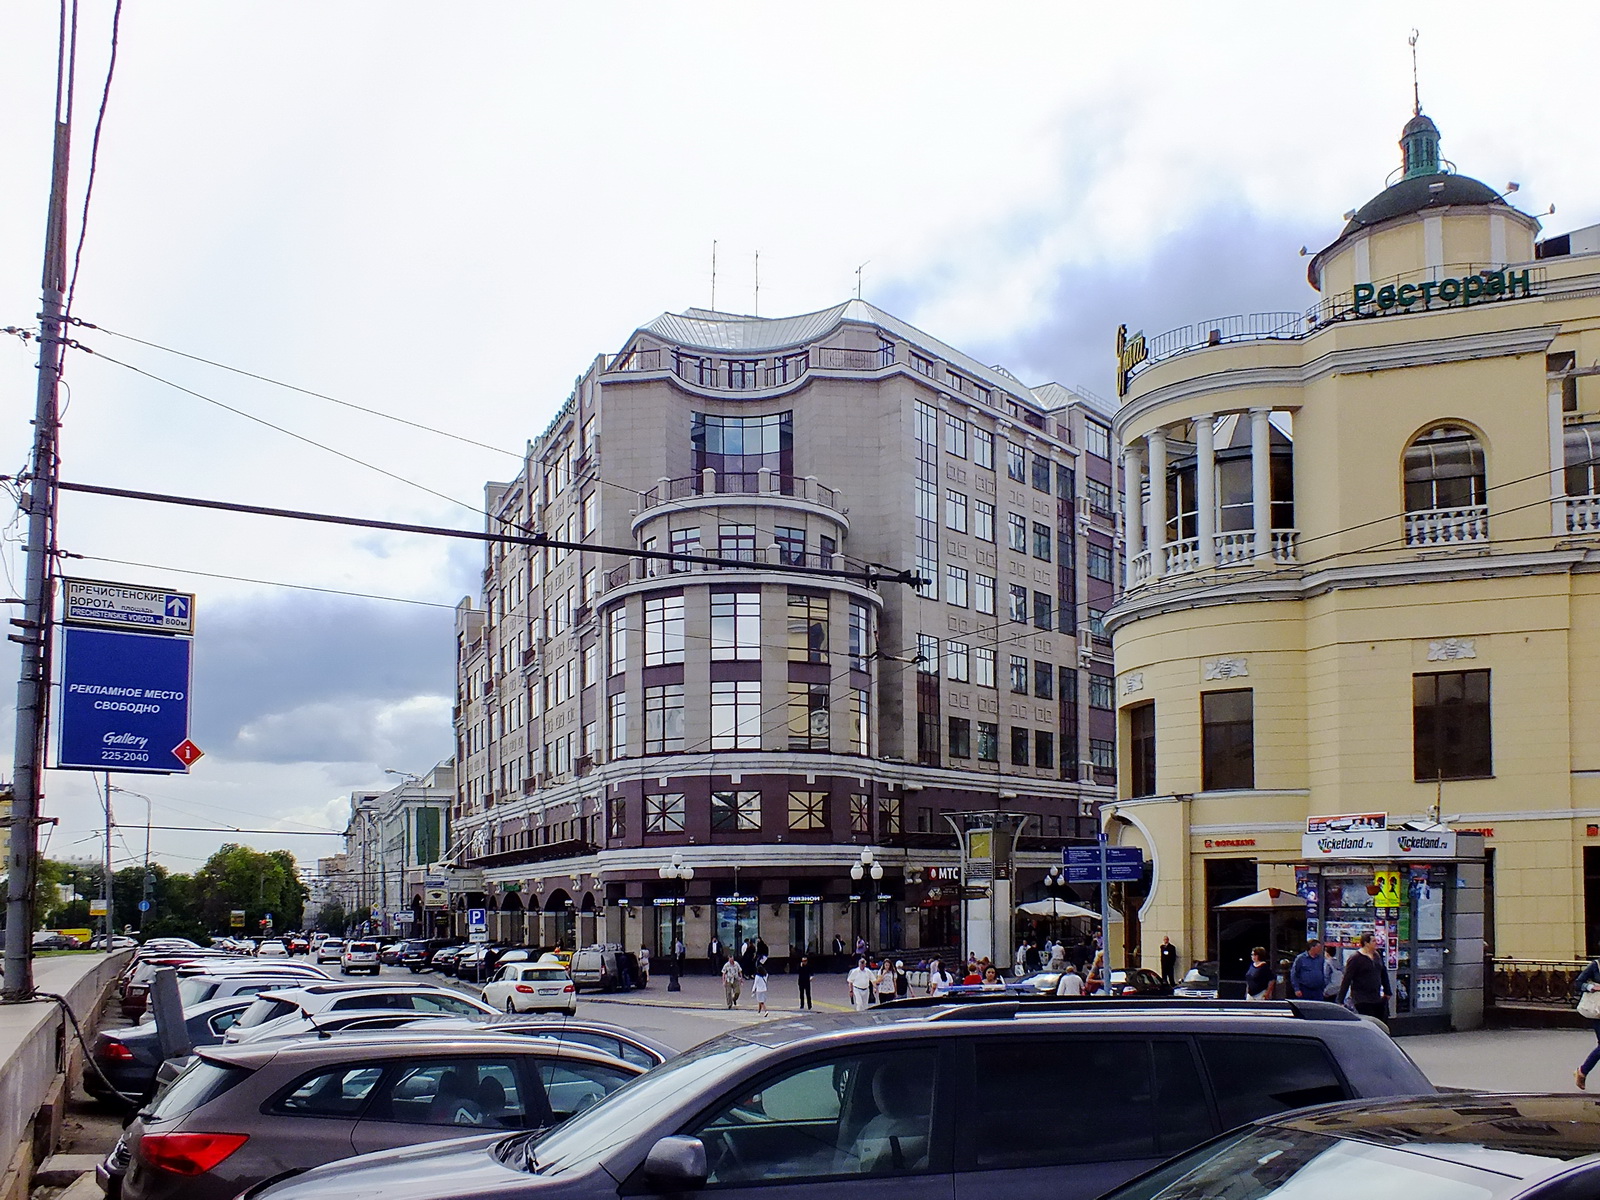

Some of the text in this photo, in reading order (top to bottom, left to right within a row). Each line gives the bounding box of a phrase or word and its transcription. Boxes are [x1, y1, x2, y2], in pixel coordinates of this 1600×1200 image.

[1354, 266, 1529, 313] Ресторан
[70, 584, 164, 603] ПРЕЧИСТЕНСКИЕ
[70, 596, 115, 609] ВОРОТА
[128, 613, 155, 623] VOROTA
[69, 684, 184, 700] РЕКЛАМНОЕ МЕСТО
[94, 701, 160, 714] СВОБОДНО
[103, 732, 149, 749] Gallery
[101, 751, 149, 761] 225-2040
[1321, 837, 1373, 850] Ticketland.ru
[1401, 836, 1448, 849] Ticketland.ru
[939, 867, 959, 880] МТС
